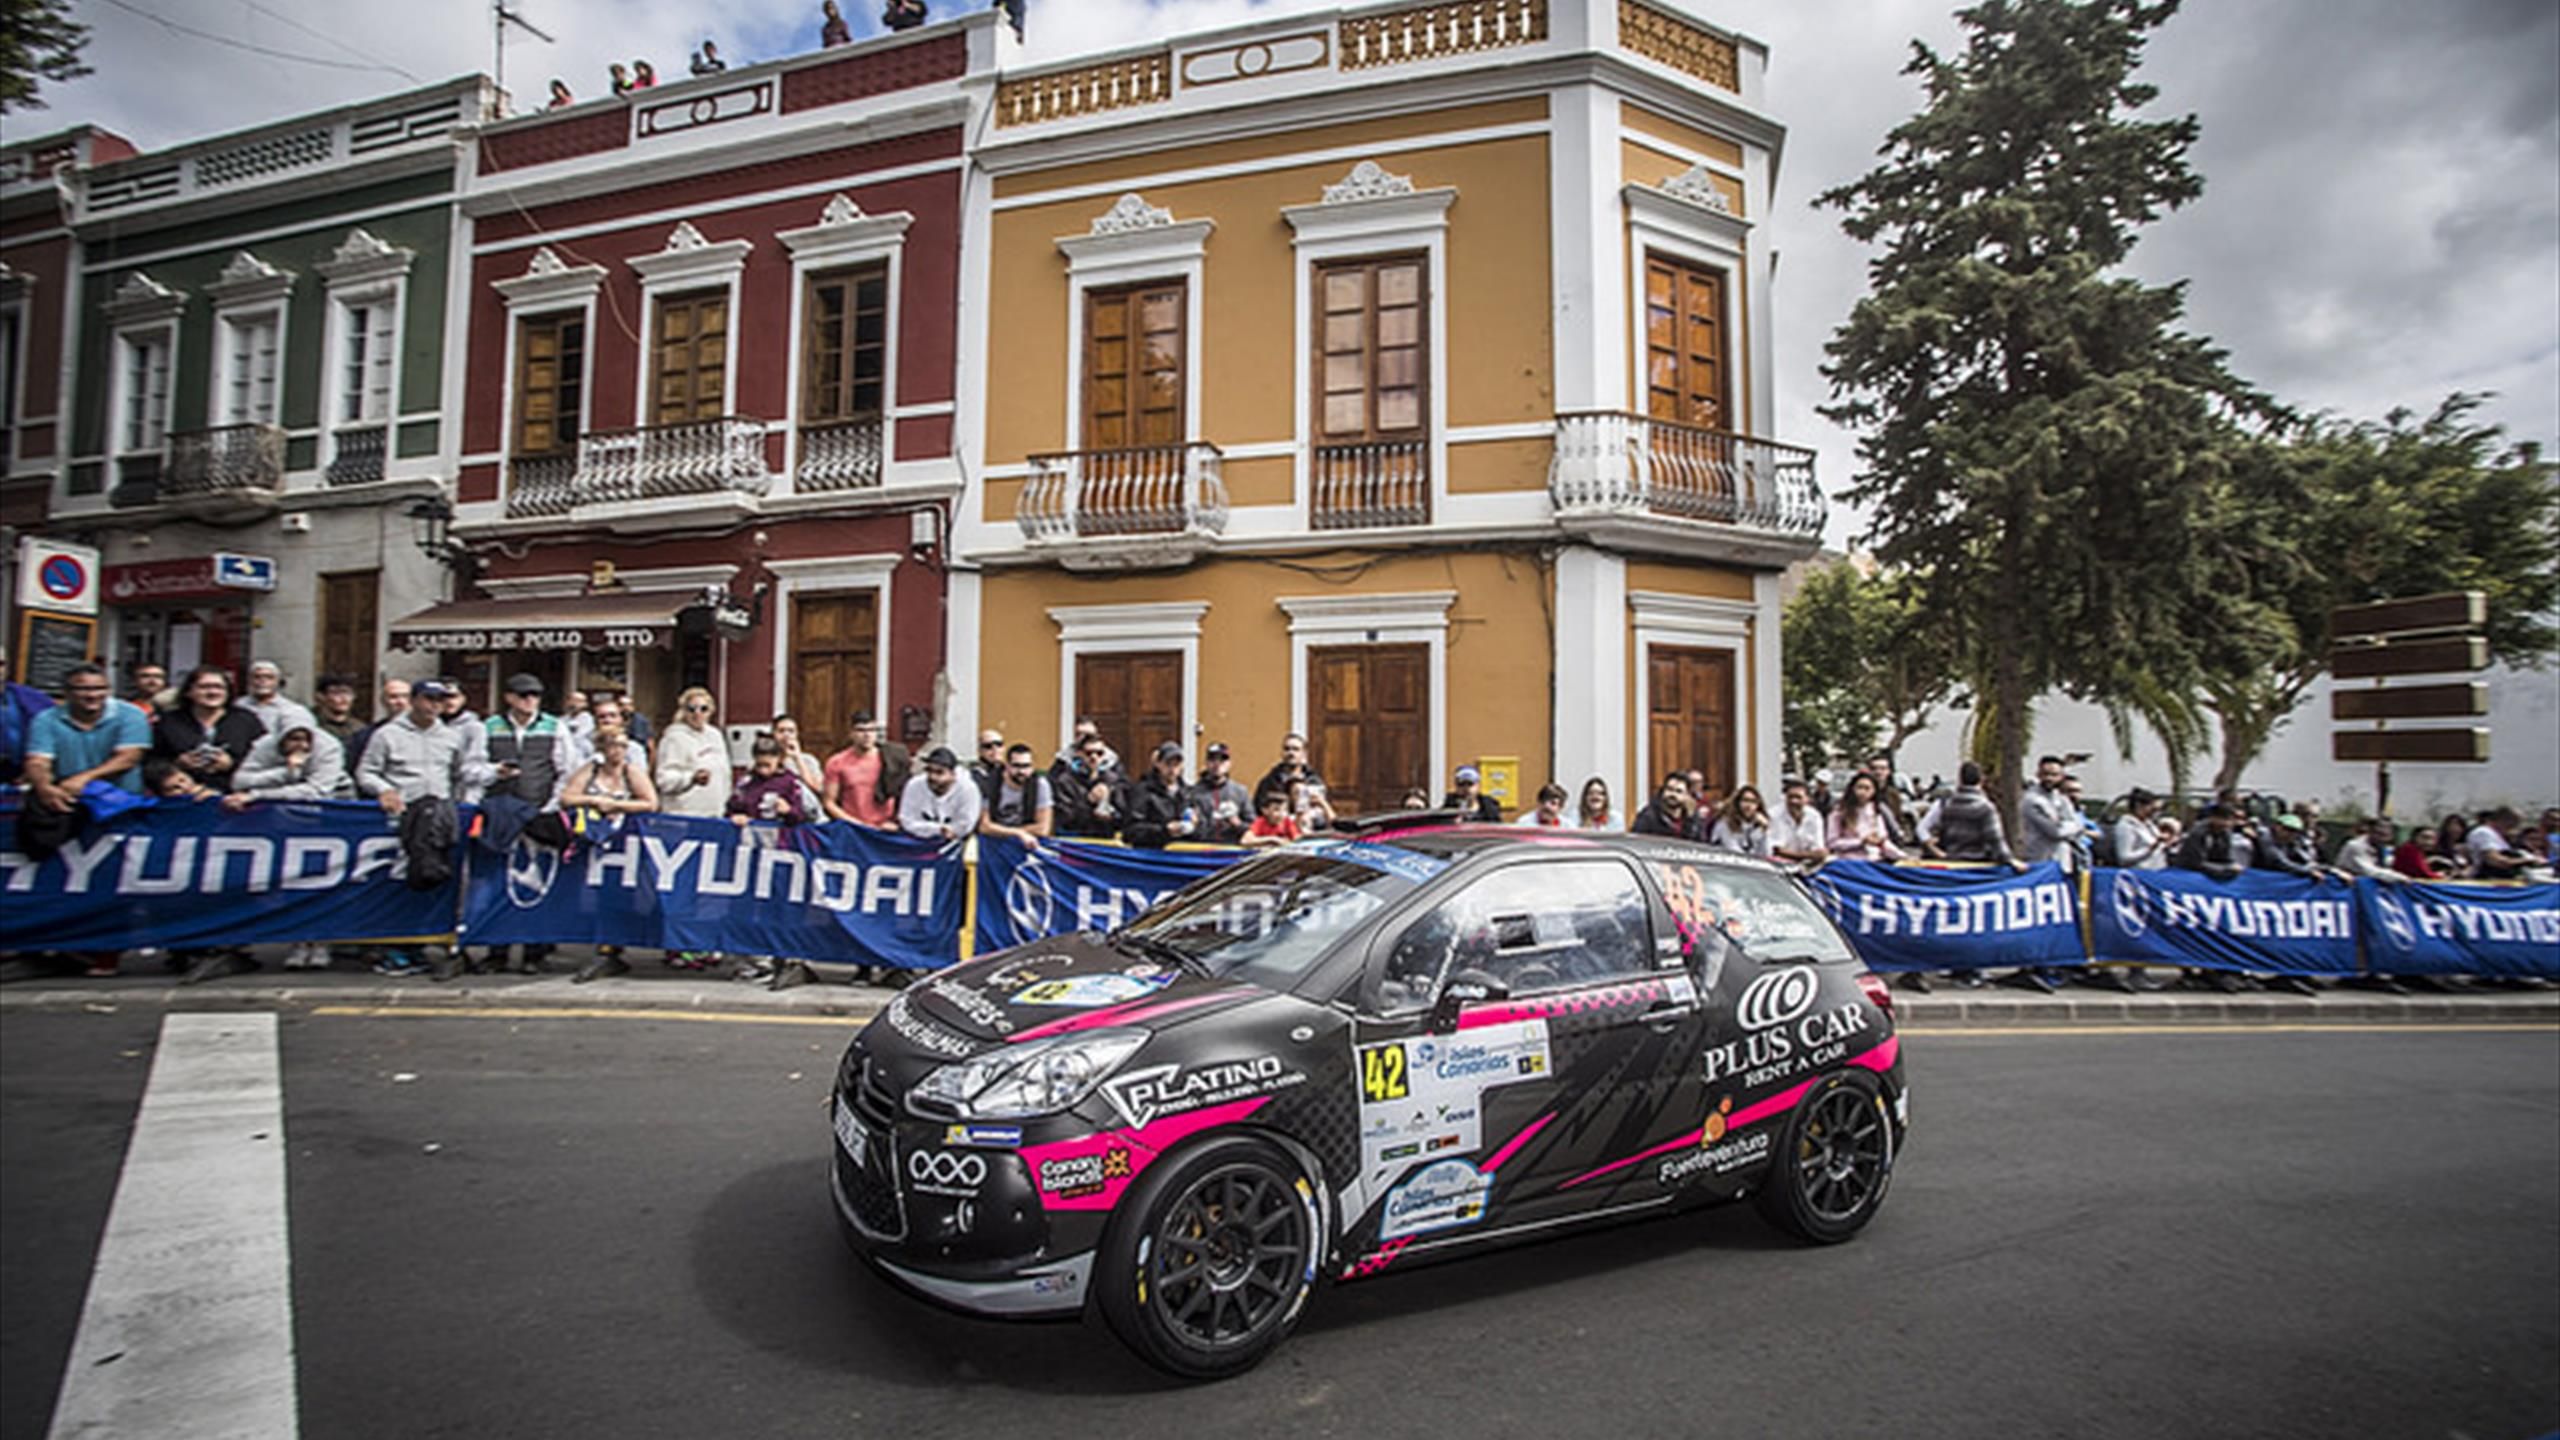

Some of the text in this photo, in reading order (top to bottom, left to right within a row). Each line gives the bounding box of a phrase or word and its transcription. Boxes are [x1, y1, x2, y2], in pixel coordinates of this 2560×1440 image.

[491, 632, 518, 648] DE
[523, 631, 582, 648] POLLO
[604, 629, 653, 646] TITO
[0, 834, 408, 893] YUNDA
[586, 834, 935, 916] HYUNDAI
[1859, 883, 2072, 935] HYUNDAI
[2161, 891, 2349, 939] HYUNDAI
[1702, 1002, 1868, 1083] PLUS CAR
[1745, 1043, 1847, 1088] RENT A CAR
[1129, 1056, 1281, 1112] PLATINO
[1365, 1045, 1405, 1100] 42
[1040, 1156, 1104, 1177] Canary
